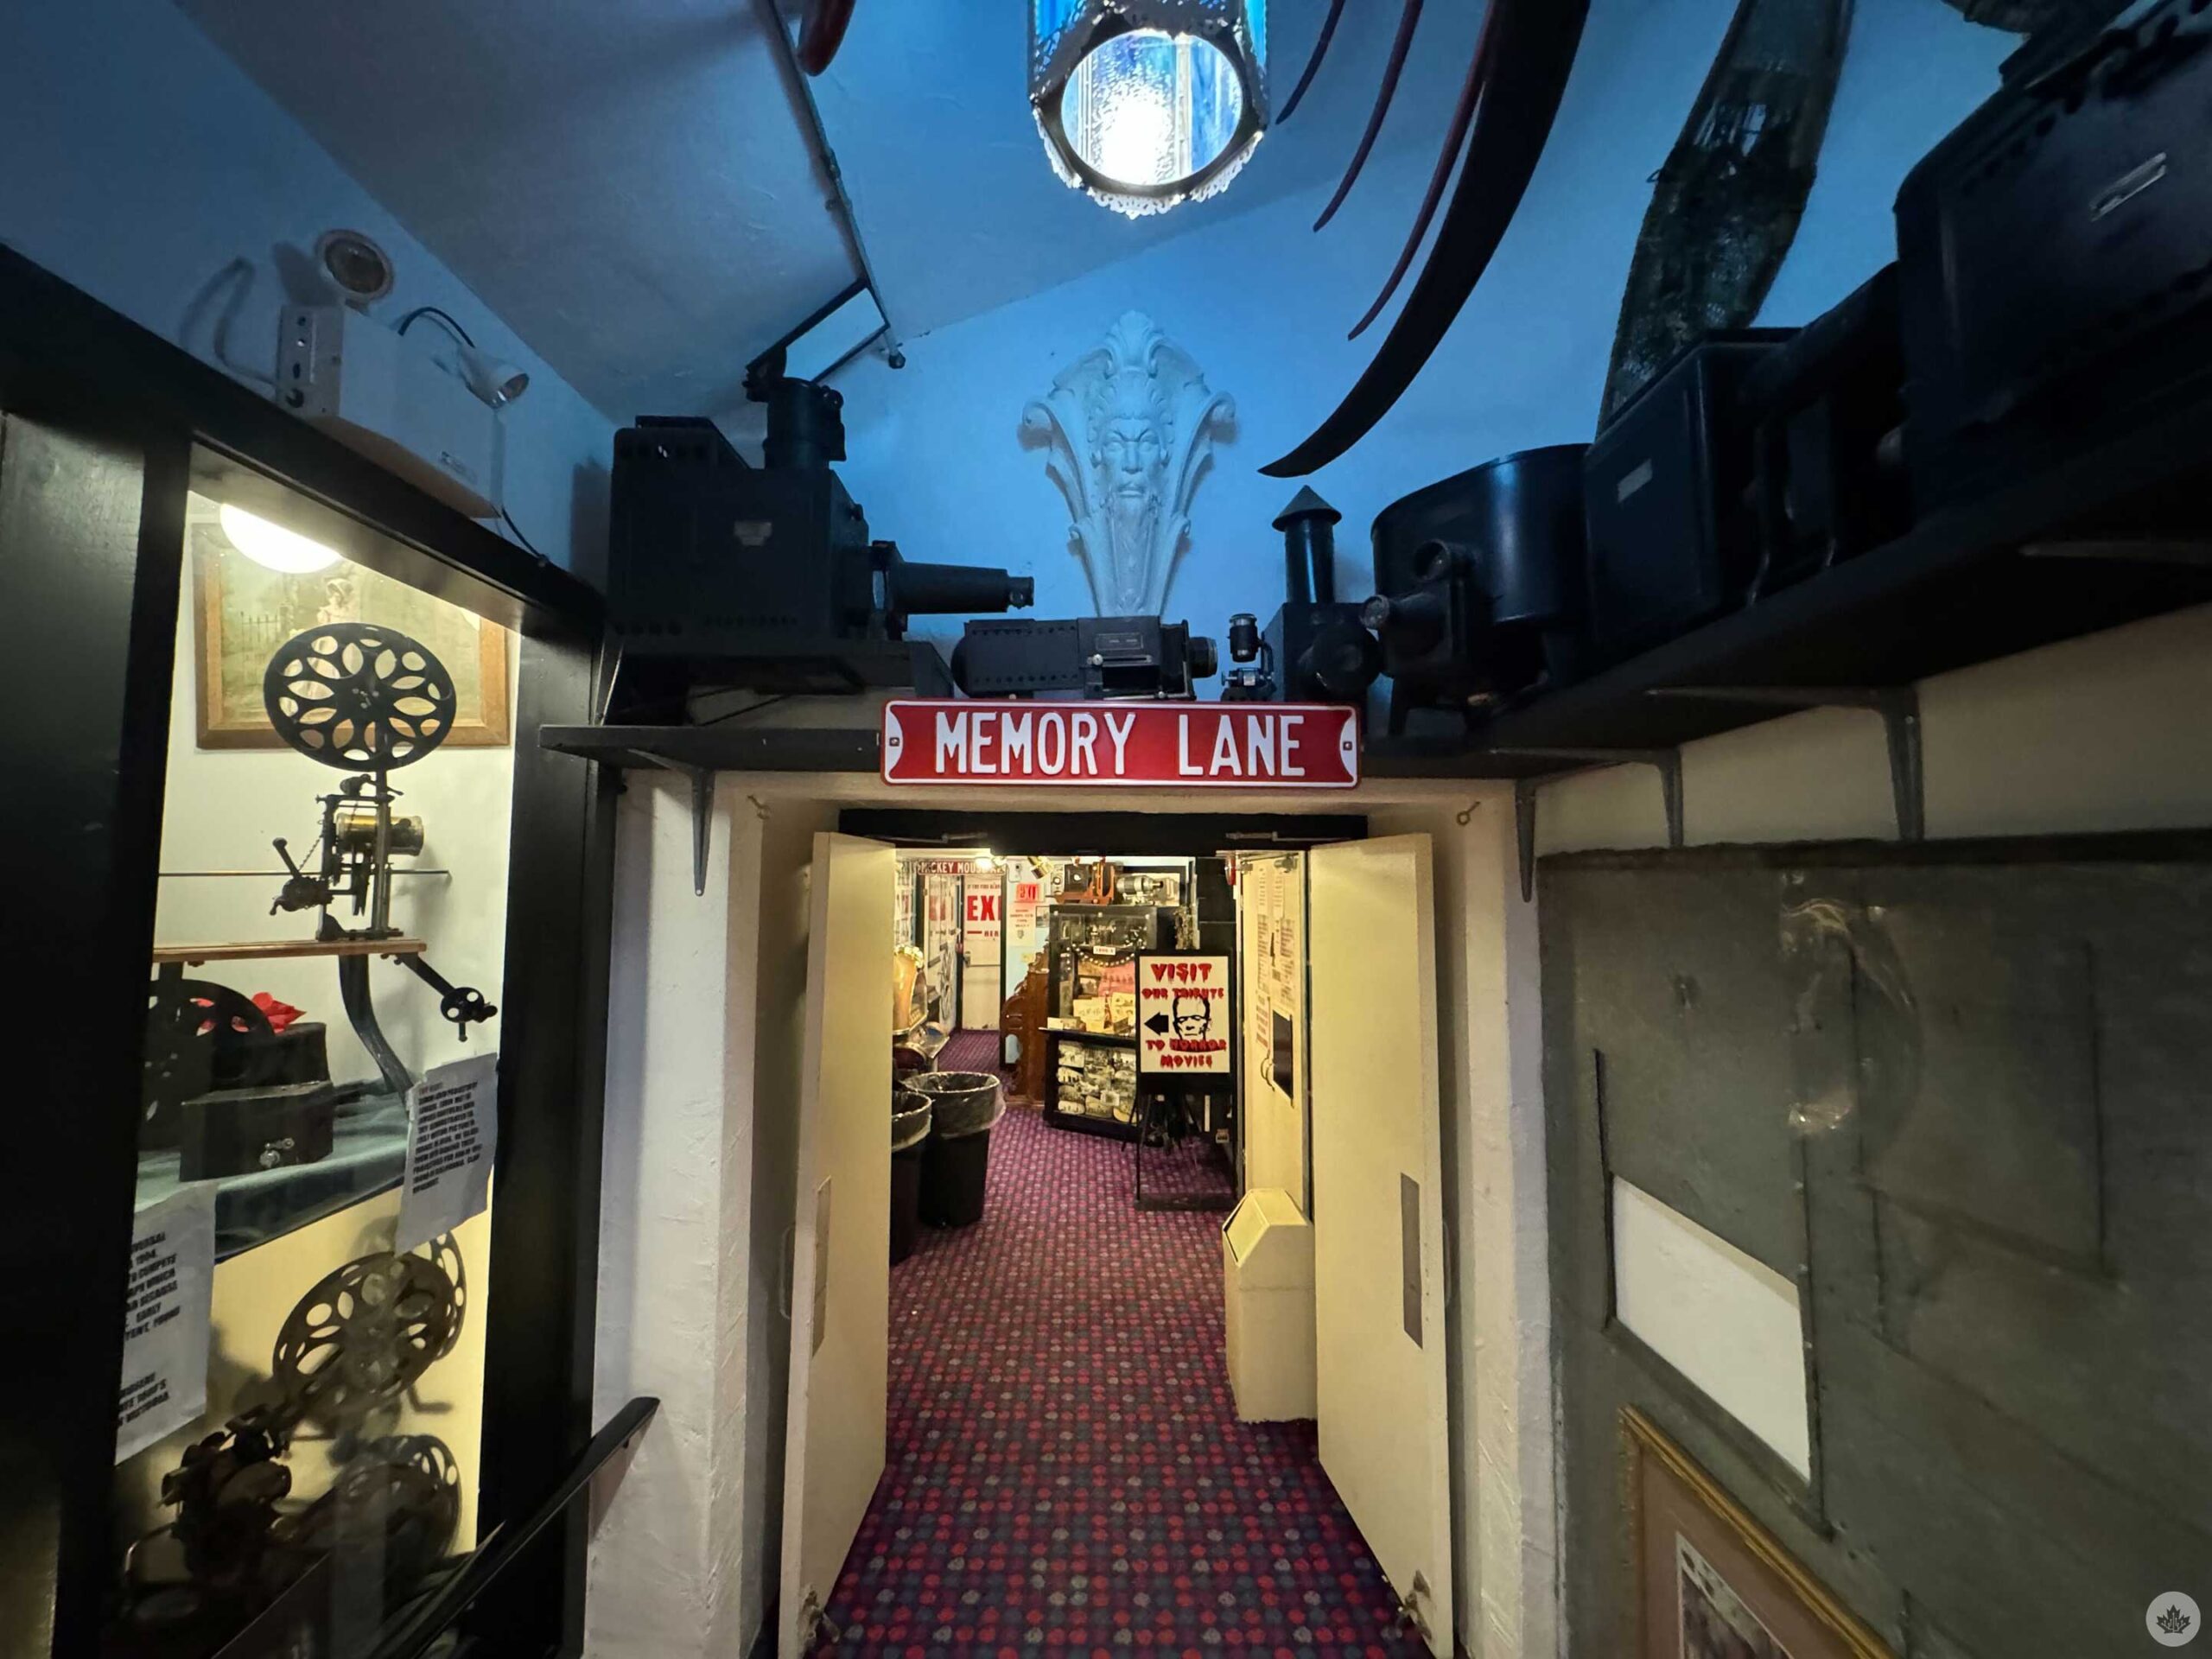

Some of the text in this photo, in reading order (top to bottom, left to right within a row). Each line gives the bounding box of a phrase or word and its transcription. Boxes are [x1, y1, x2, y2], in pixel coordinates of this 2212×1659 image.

[935, 711, 1305, 776] MEMORY LANE
[1150, 963, 1212, 984] VISIT
[1141, 988, 1224, 1001] OUR TRIBUTE
[1146, 1038, 1227, 1052] TO HORROR
[1160, 1054, 1212, 1070] MOVIES
